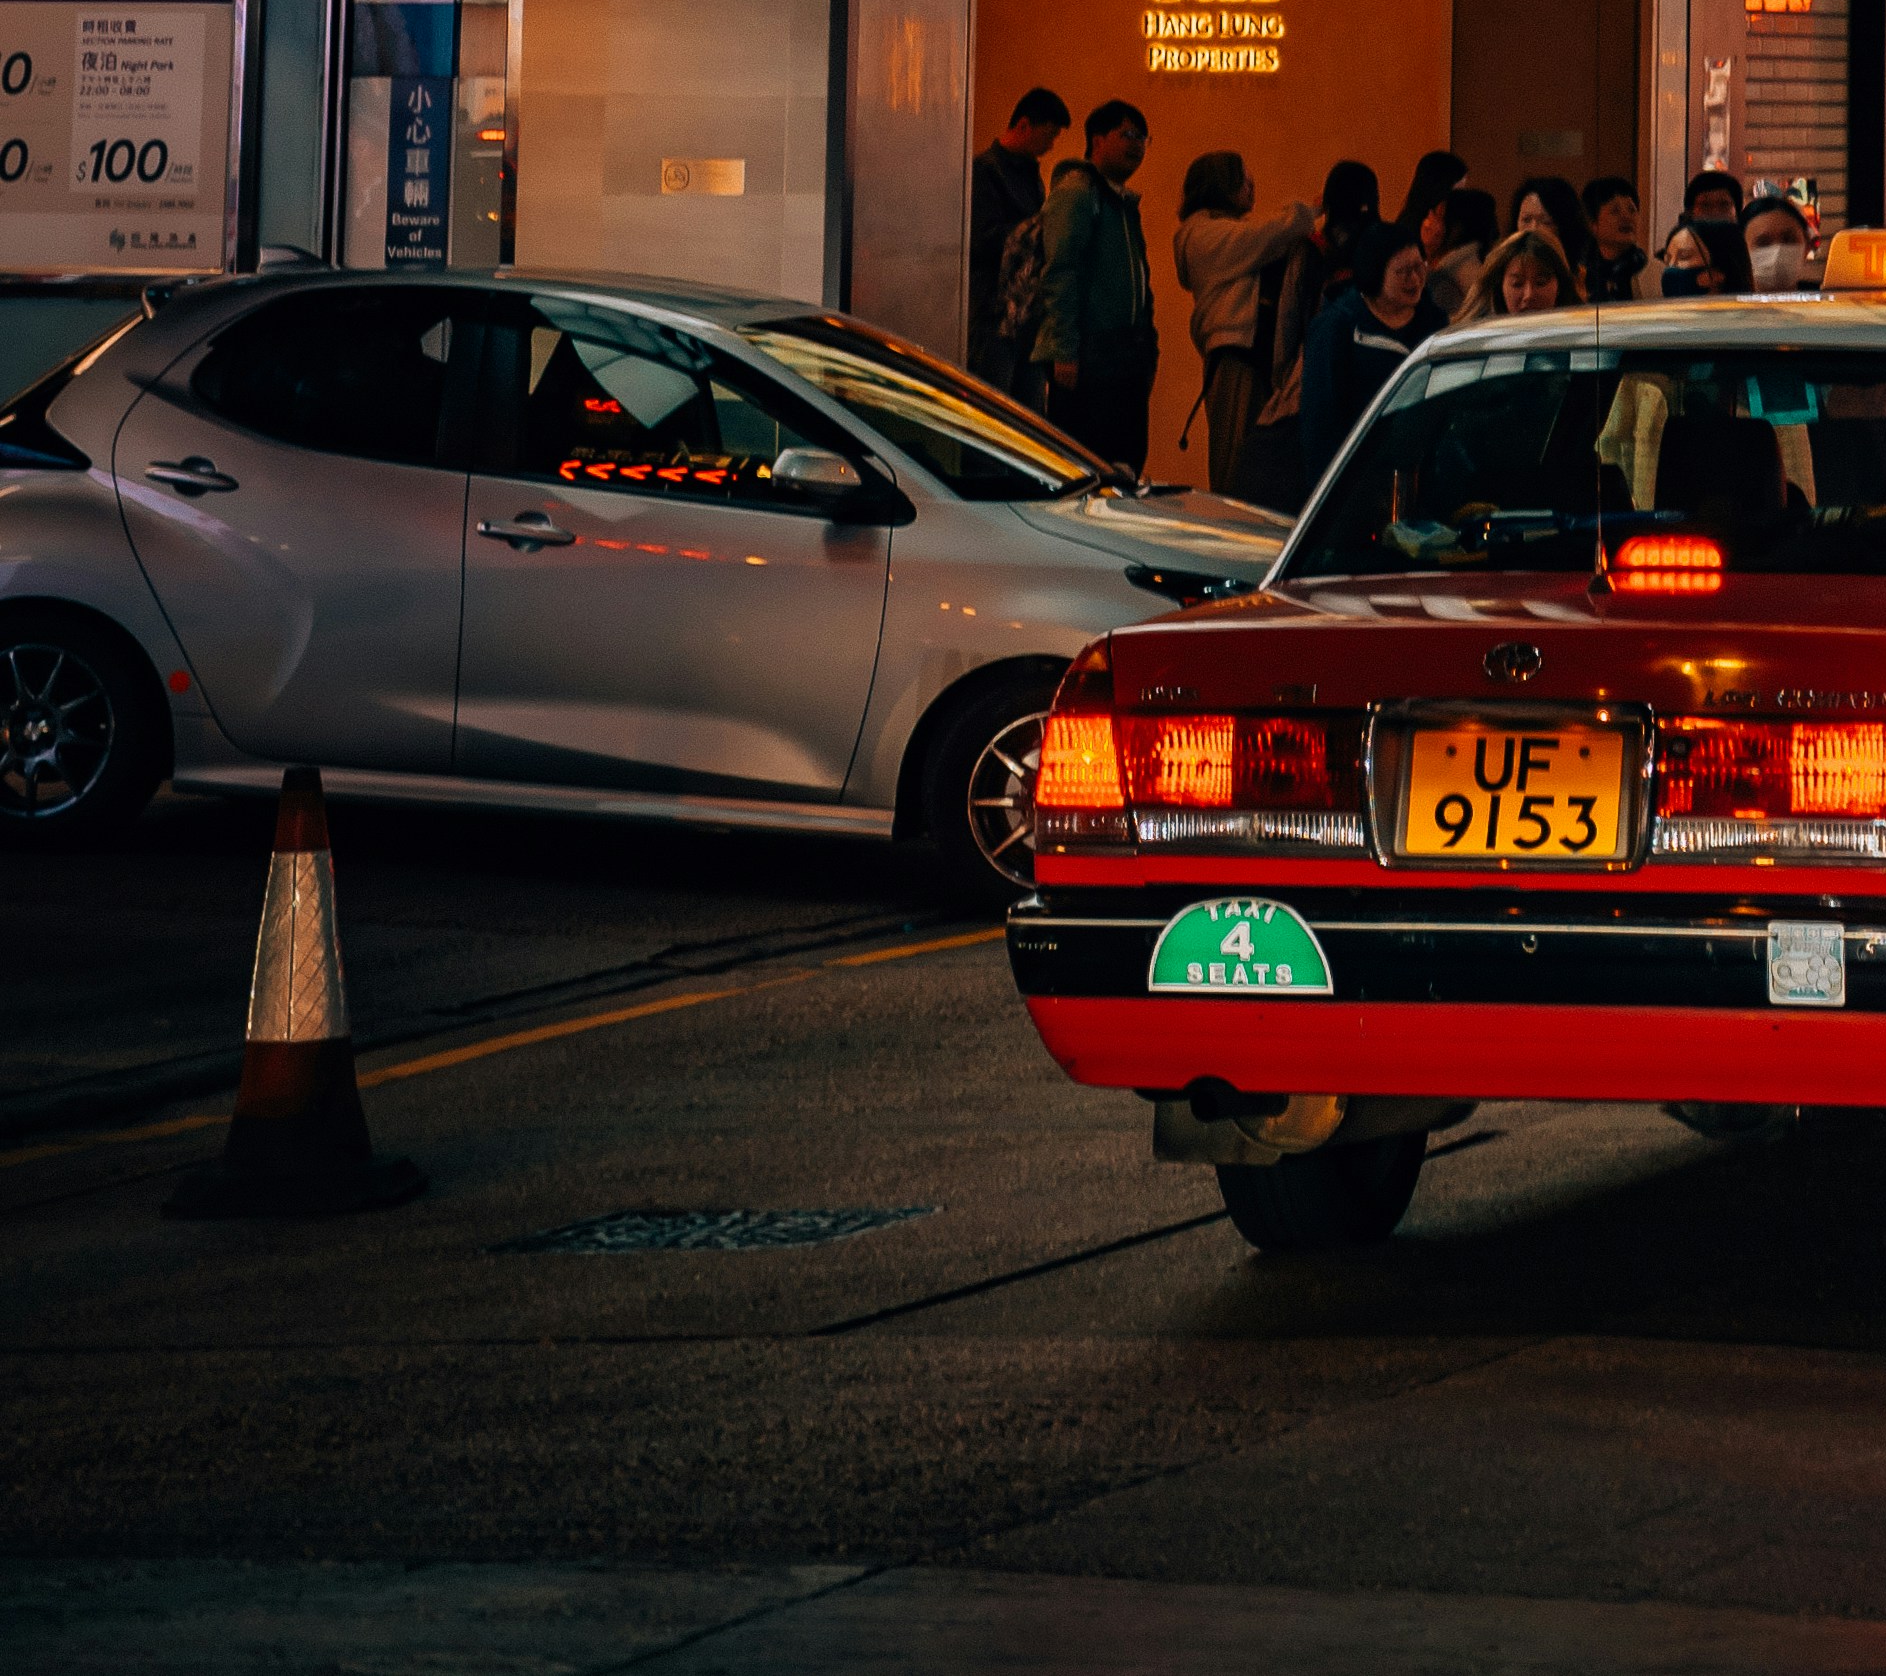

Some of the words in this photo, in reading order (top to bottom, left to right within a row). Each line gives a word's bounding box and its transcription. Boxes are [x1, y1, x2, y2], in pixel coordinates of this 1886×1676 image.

[1143, 10, 1213, 39] HANG
[1218, 10, 1286, 39] LUNG
[1147, 42, 1280, 73] PROPERTIES
[391, 212, 441, 226] Beware
[408, 229, 423, 242] of
[387, 245, 443, 260] Vehicles
[1473, 736, 1563, 793] UF
[1434, 795, 1600, 851] 9153
[1204, 900, 1280, 924] TAXI
[1219, 920, 1255, 962] 4
[1186, 962, 1293, 986] SEATS
